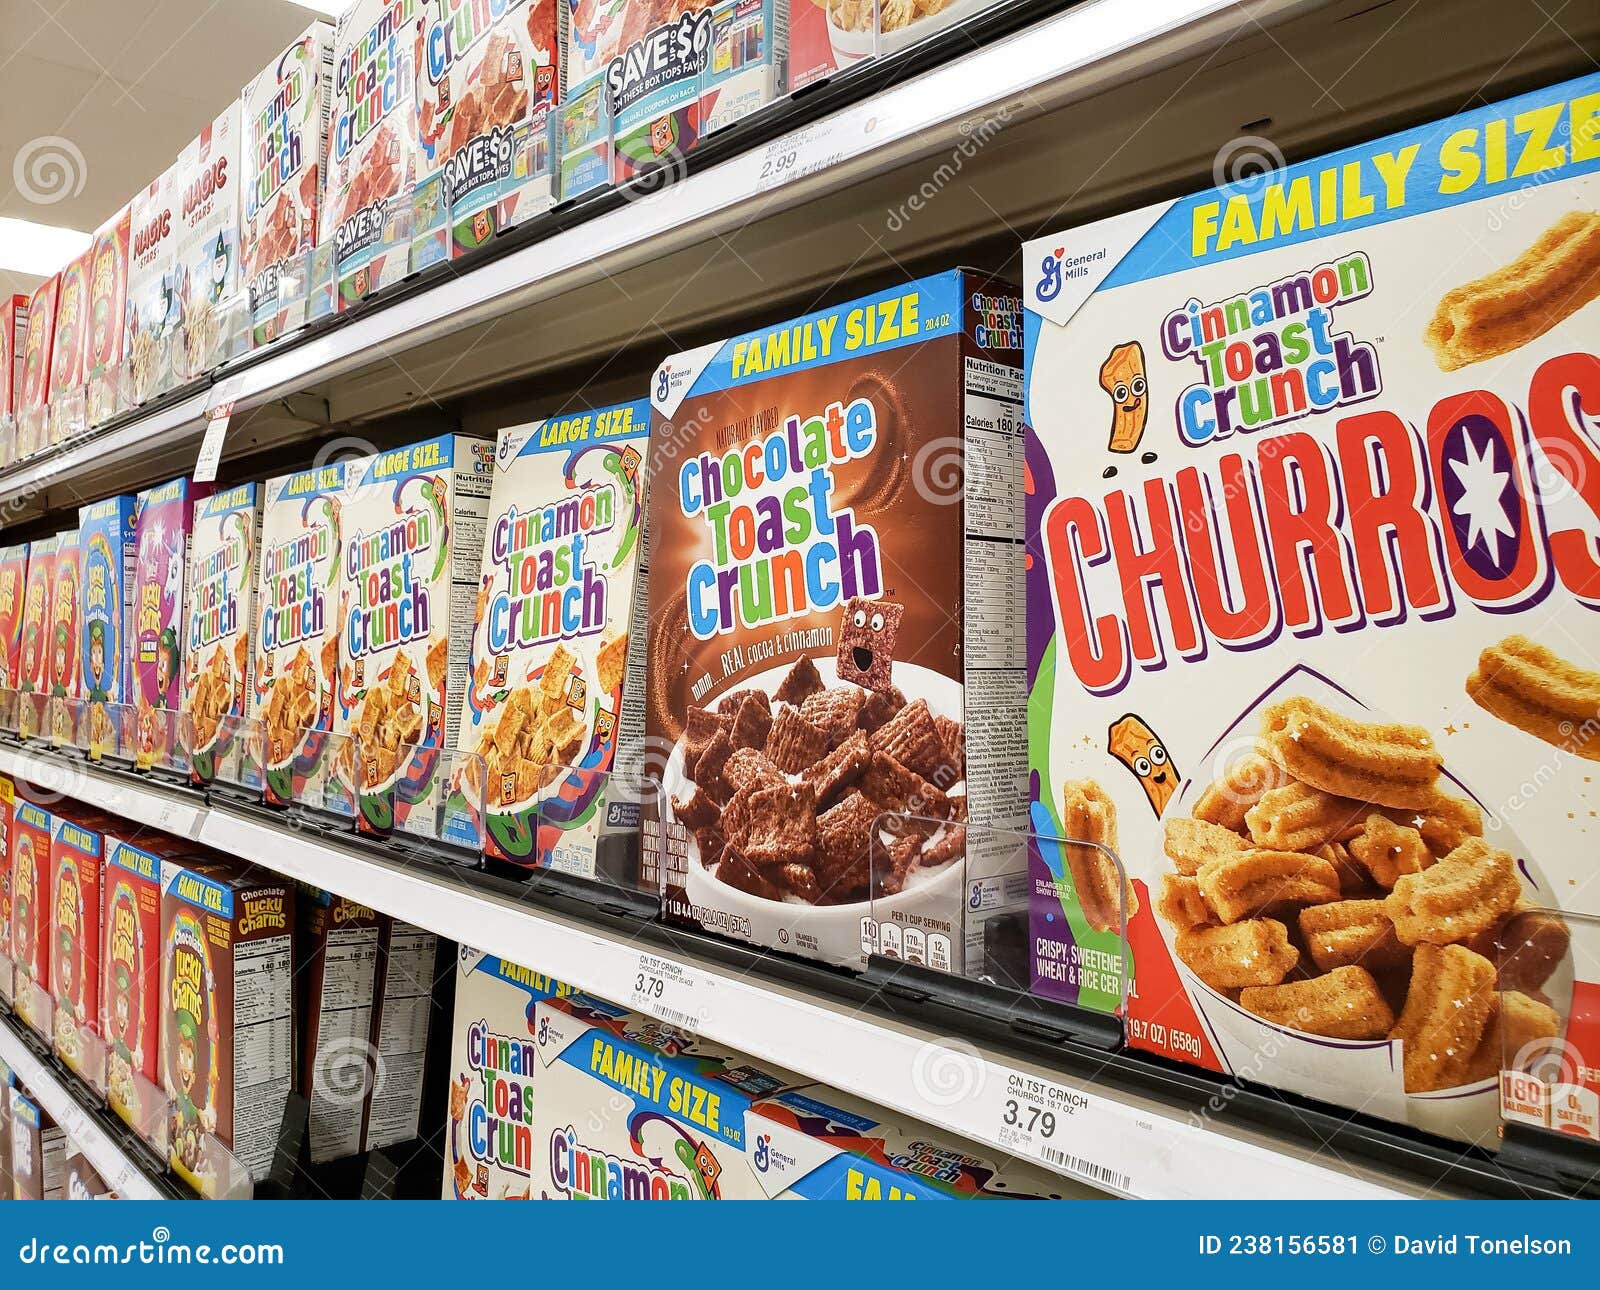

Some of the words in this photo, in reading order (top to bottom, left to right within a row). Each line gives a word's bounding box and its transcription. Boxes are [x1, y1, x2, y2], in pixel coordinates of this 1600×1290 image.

[348, 35, 397, 112] Toast
[610, 32, 670, 97] SAVE
[678, 15, 710, 63] $6
[622, 85, 643, 105] THESE
[644, 77, 660, 93] BOX
[661, 67, 682, 87] TOPS
[678, 85, 696, 100] BACK
[337, 52, 413, 159] Crunch
[445, 141, 484, 190] SAVE
[480, 170, 494, 183] TOPS
[760, 151, 797, 179] 2.99
[1192, 144, 1420, 257] FAMILY
[1439, 92, 1600, 194] SIZE
[336, 209, 368, 252] SAVE
[1065, 248, 1106, 268] General
[1065, 264, 1090, 280] Mills
[972, 293, 1024, 313] Chocolate
[982, 311, 1017, 329] Toast
[1165, 254, 1371, 352] Cinnamon
[732, 315, 838, 379] FAMILY
[846, 292, 919, 351] SIZE
[925, 316, 939, 330] 20.4
[976, 324, 1024, 349] Crunch
[1201, 307, 1332, 388] Toast
[670, 367, 692, 380] General
[670, 378, 683, 388] Mills
[966, 358, 1006, 376] Nutrition
[966, 381, 985, 392] Serving
[1180, 337, 1377, 440] Crunch
[539, 418, 589, 447] LARGE
[594, 407, 633, 438] SIZE
[716, 418, 749, 449] NATURALLY
[749, 406, 779, 435] FLAVORED
[966, 415, 994, 429] Calories
[997, 419, 1013, 432] 180
[373, 453, 409, 479] LARGE
[412, 442, 440, 472] SIZE
[681, 402, 873, 513] Chocolate
[289, 473, 316, 495] LARGE
[318, 467, 338, 491] SIZE
[456, 474, 492, 483] Nutritio
[455, 508, 476, 516] Calories
[495, 491, 612, 558] Cinnamon
[708, 468, 834, 566] Toast
[1046, 352, 1600, 692] CHURROS
[265, 529, 326, 578] Cinnamon
[349, 512, 429, 575] Cinnamon
[194, 540, 238, 585] Cinnamon
[510, 534, 585, 597] Toast
[689, 513, 880, 635] Crunch
[198, 570, 227, 612] Toast
[273, 563, 312, 607] Toast
[360, 553, 412, 610] Toast
[192, 593, 237, 647] Crunch
[264, 588, 323, 650] Crunch
[350, 582, 428, 654] Crunch
[491, 568, 605, 648] Crunch
[747, 641, 775, 663] cocoa
[783, 625, 833, 655] cinnamon
[178, 875, 202, 903] FAMILY
[204, 886, 222, 911] SIZE
[241, 888, 285, 902] Chocolate
[1035, 879, 1062, 891] ENLARGED
[1036, 886, 1051, 896] SHOW
[239, 913, 286, 935] Charms
[673, 902, 681, 916] LB
[682, 904, 691, 918] 4.4
[692, 907, 700, 921] OZ
[892, 911, 903, 921] PER
[910, 915, 922, 925] CUP
[924, 918, 951, 932] SERVING
[639, 963, 664, 978] CHOCOLATE
[665, 971, 678, 982] TOAST
[640, 955, 648, 964] CN
[650, 958, 661, 968] TST
[661, 961, 683, 976] CRNCH
[1036, 937, 1069, 964] CRISPY,
[1071, 946, 1125, 978] SWEETENE
[635, 973, 664, 998] 3.79
[1037, 958, 1066, 984] WHEAT
[1068, 969, 1076, 984] &
[1078, 969, 1098, 992] RICE
[1101, 975, 1140, 999] CERAL
[1151, 1023, 1167, 1050] OZ)
[1170, 1027, 1202, 1059] (558g)
[485, 1069, 533, 1125] Toas
[591, 1038, 667, 1103] FAMILY
[668, 1077, 721, 1132] SIZE
[1006, 1086, 1045, 1105] CHURROS
[1046, 1099, 1062, 1111] 19.7
[1063, 1104, 1075, 1115] OZ
[1008, 1074, 1024, 1089] CN
[1026, 1080, 1046, 1095] TST
[1048, 1087, 1089, 1110] CRNCH
[1504, 1076, 1541, 1105] 180
[1003, 1099, 1056, 1139] 3.79
[1557, 1109, 1573, 1121] SAT
[1576, 1112, 1593, 1126] FAT
[471, 1104, 531, 1170] Crun
[910, 1142, 981, 1167] Cinnamon
[771, 1149, 796, 1166] General
[771, 1159, 785, 1172] Mills
[892, 1155, 961, 1183] Crunch
